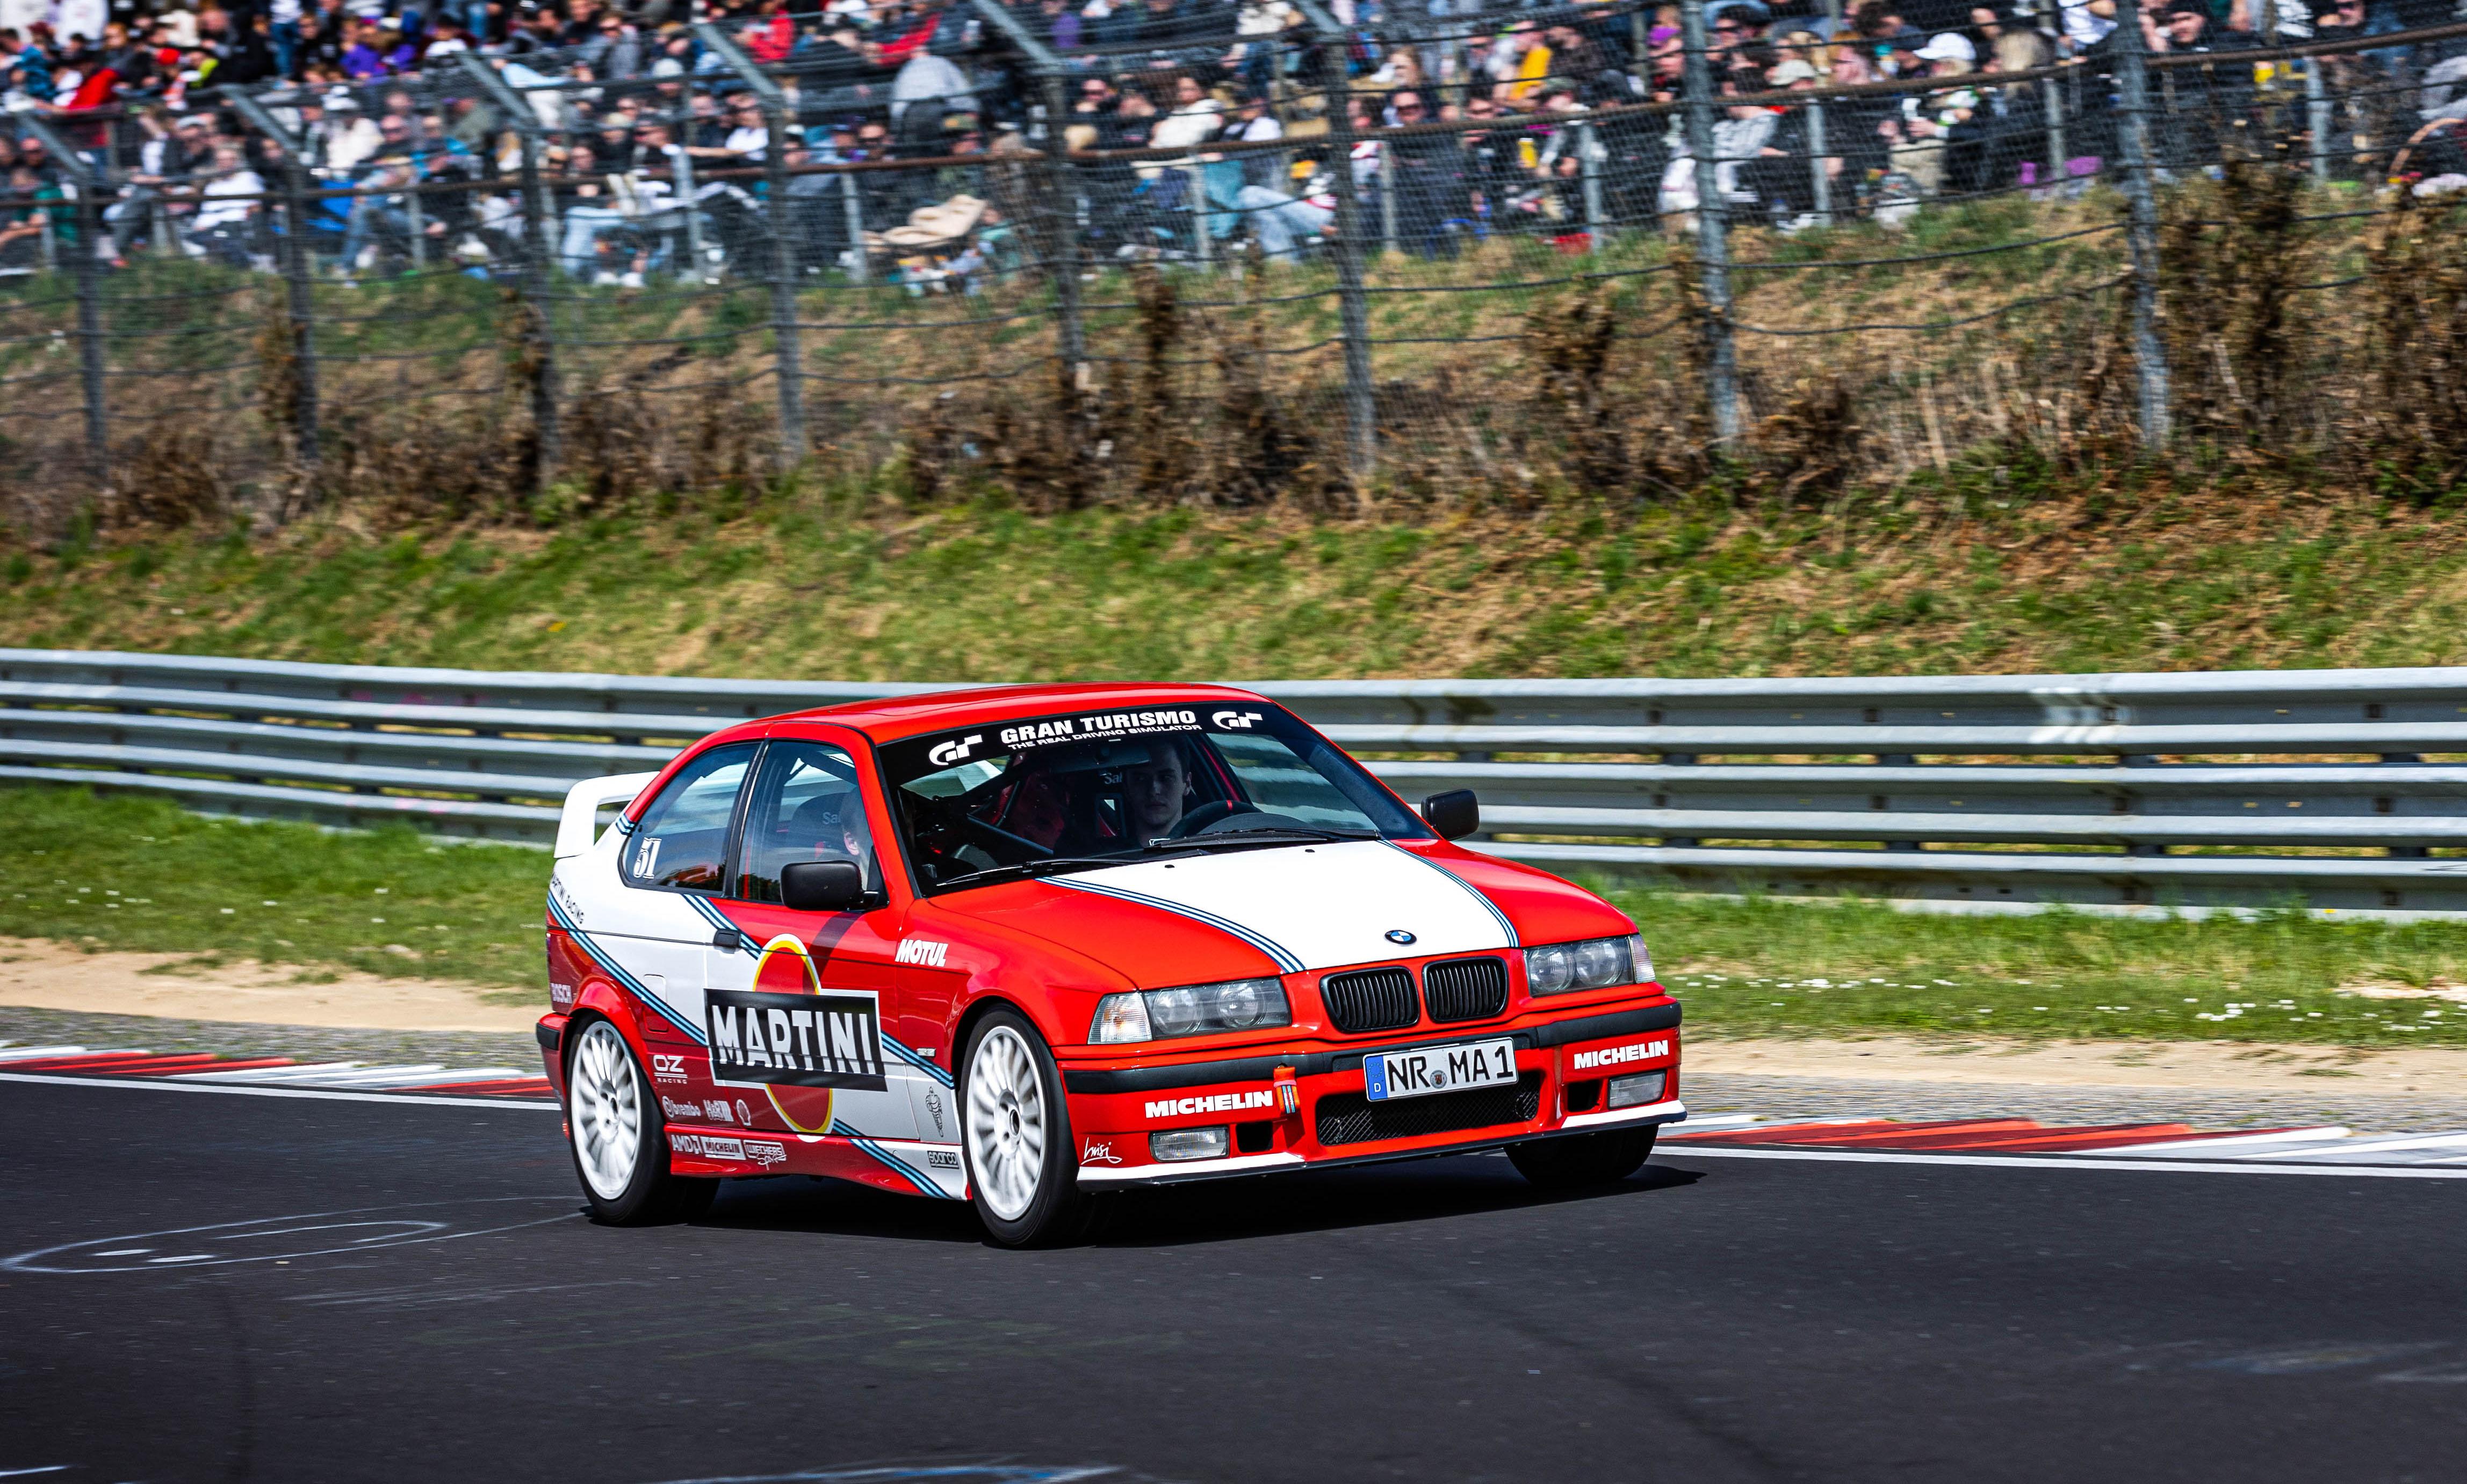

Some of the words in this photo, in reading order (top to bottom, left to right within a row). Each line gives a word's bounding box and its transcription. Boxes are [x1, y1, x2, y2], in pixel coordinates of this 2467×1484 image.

[1000, 720, 1073, 744] GRAN
[1080, 711, 1196, 732] TURISMO
[1008, 740, 1036, 750] THE
[1038, 736, 1071, 745] REAL
[1074, 729, 1126, 740] DRIVING
[1128, 725, 1202, 734] SIMULATOR
[633, 837, 662, 879] 51
[895, 938, 948, 967] MOTUL
[711, 1005, 876, 1075] MARTINI
[1574, 1039, 1669, 1069] MICHELIN
[1387, 1055, 1431, 1092] NR
[1448, 1048, 1488, 1084] MA
[1494, 1045, 1513, 1079] 1
[1374, 1082, 1381, 1093] D
[1145, 1090, 1273, 1118] MICHELIN
[705, 1141, 740, 1154] MICHELIN
[928, 1152, 957, 1164] sparco
